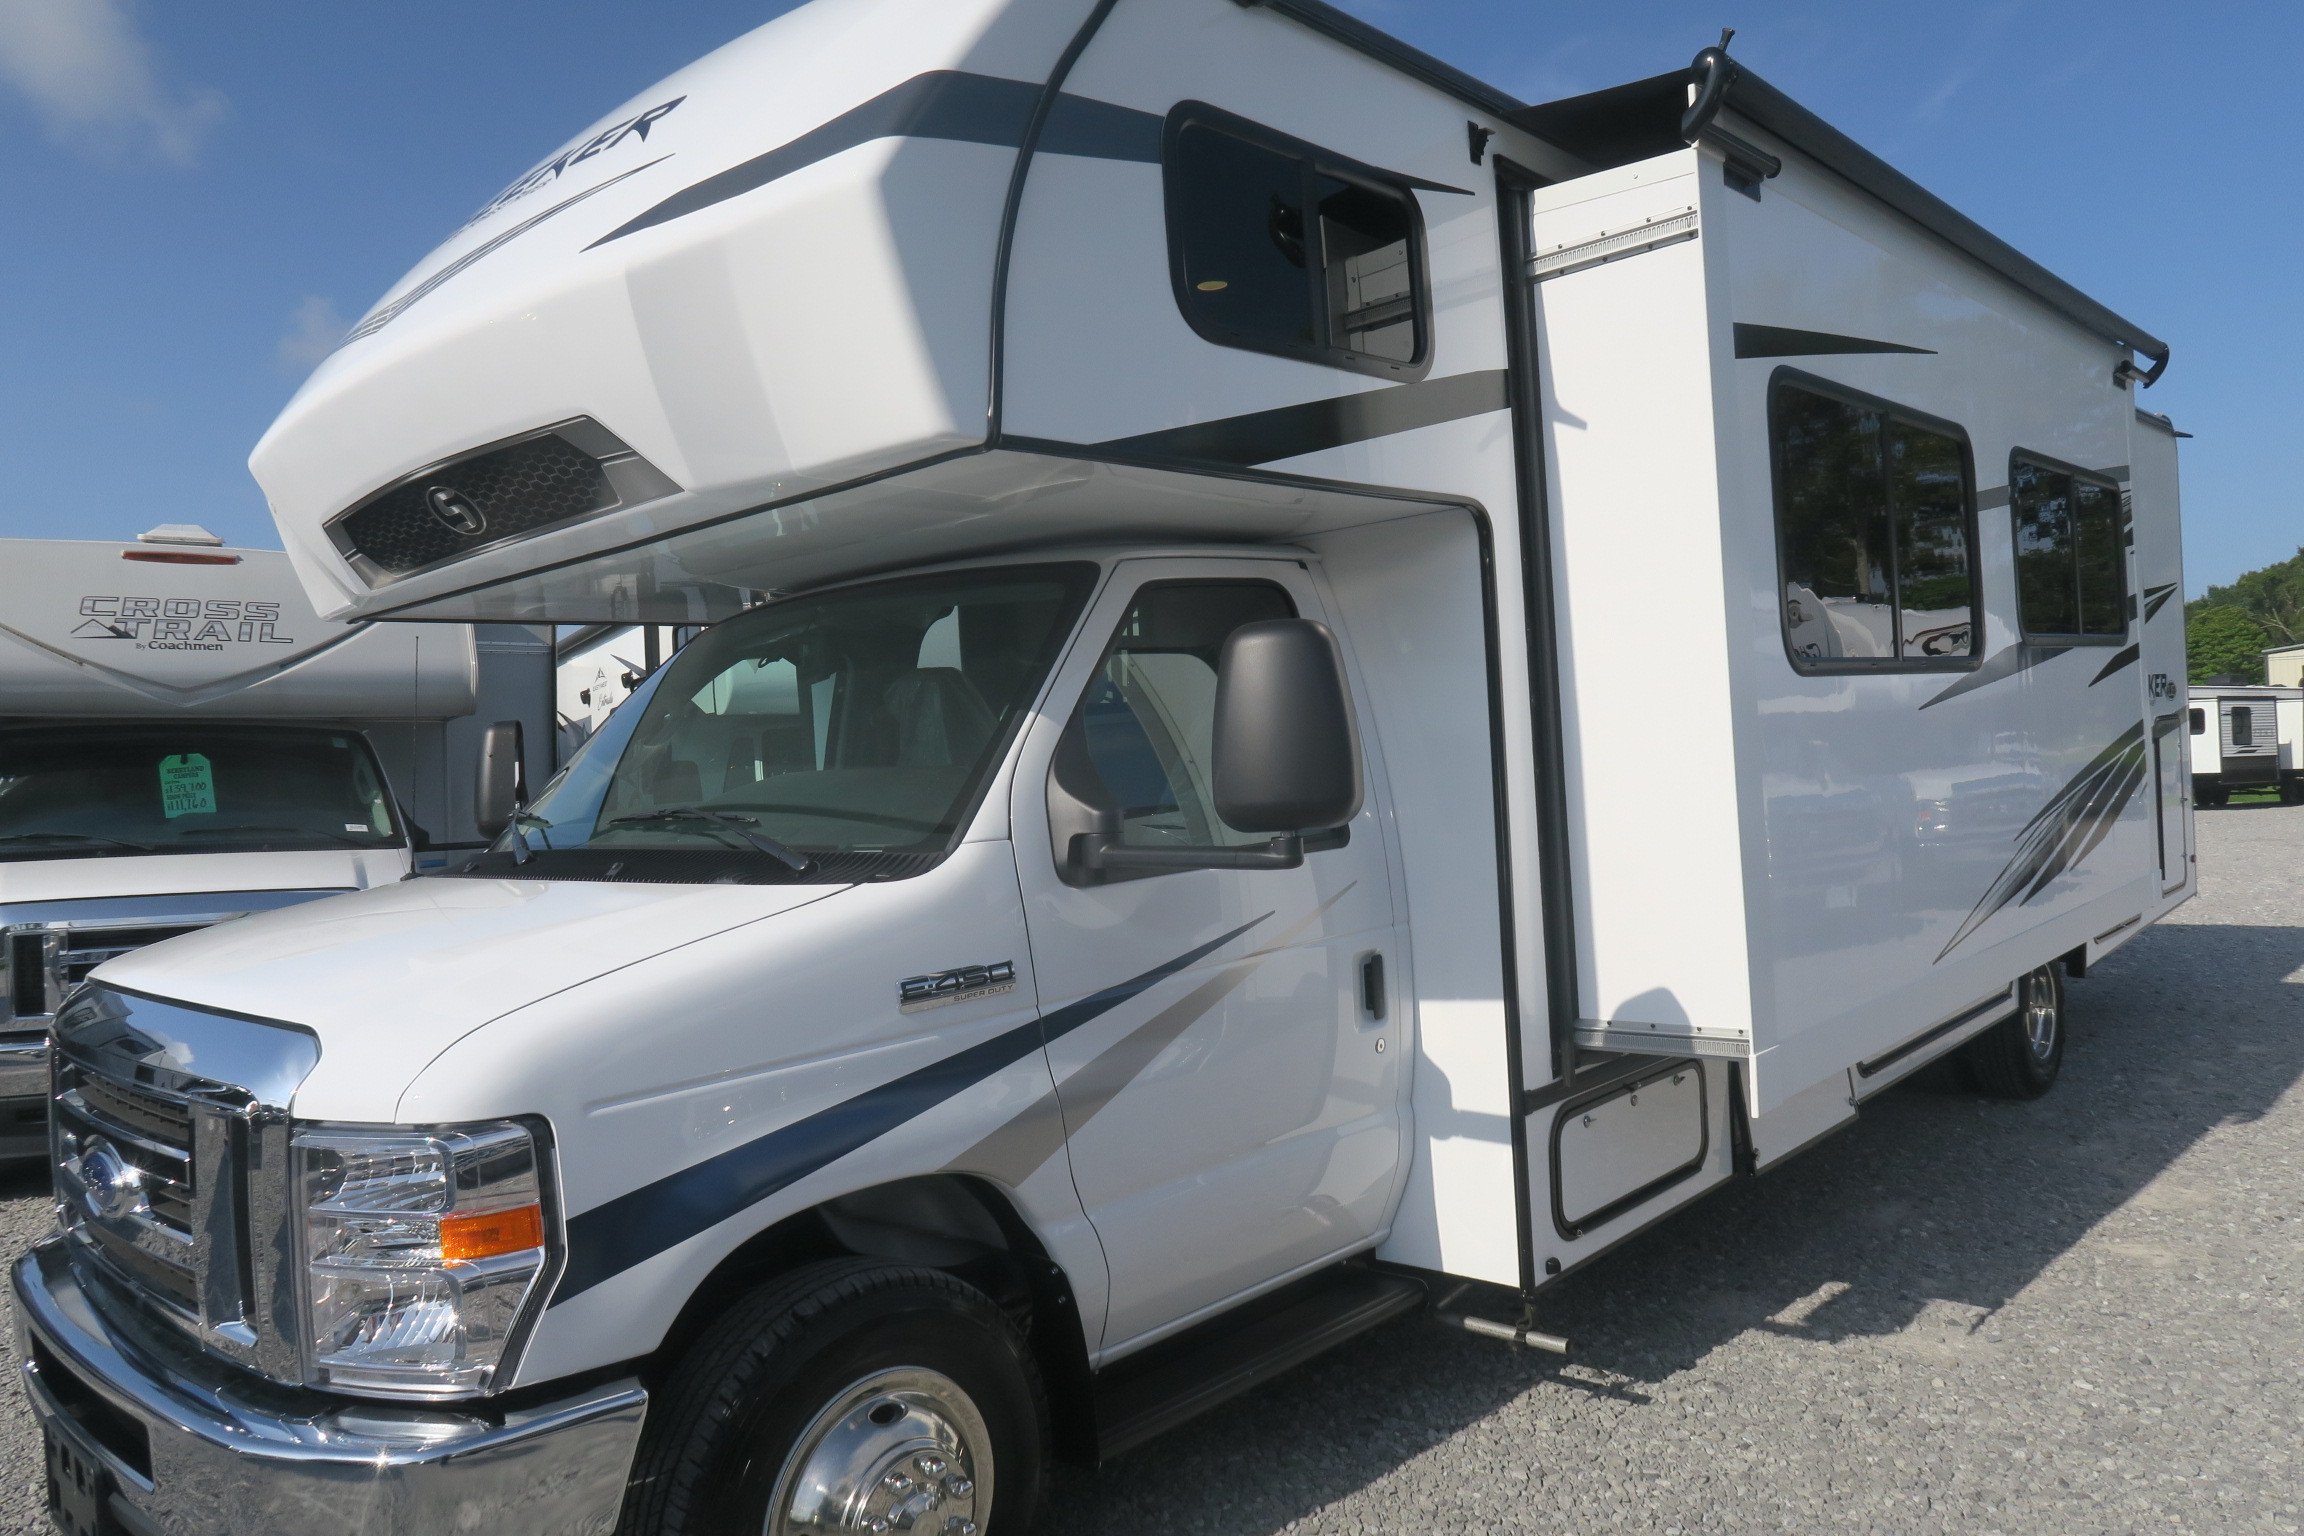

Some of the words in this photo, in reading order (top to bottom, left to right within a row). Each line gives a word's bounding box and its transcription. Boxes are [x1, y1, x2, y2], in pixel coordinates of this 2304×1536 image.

[79, 595, 281, 622] CROSS
[114, 617, 294, 644] TRAIL
[135, 642, 147, 651] By
[148, 640, 224, 651] Coachmen
[953, 989, 986, 1003] SUPER
[987, 984, 1014, 996] DUTY
